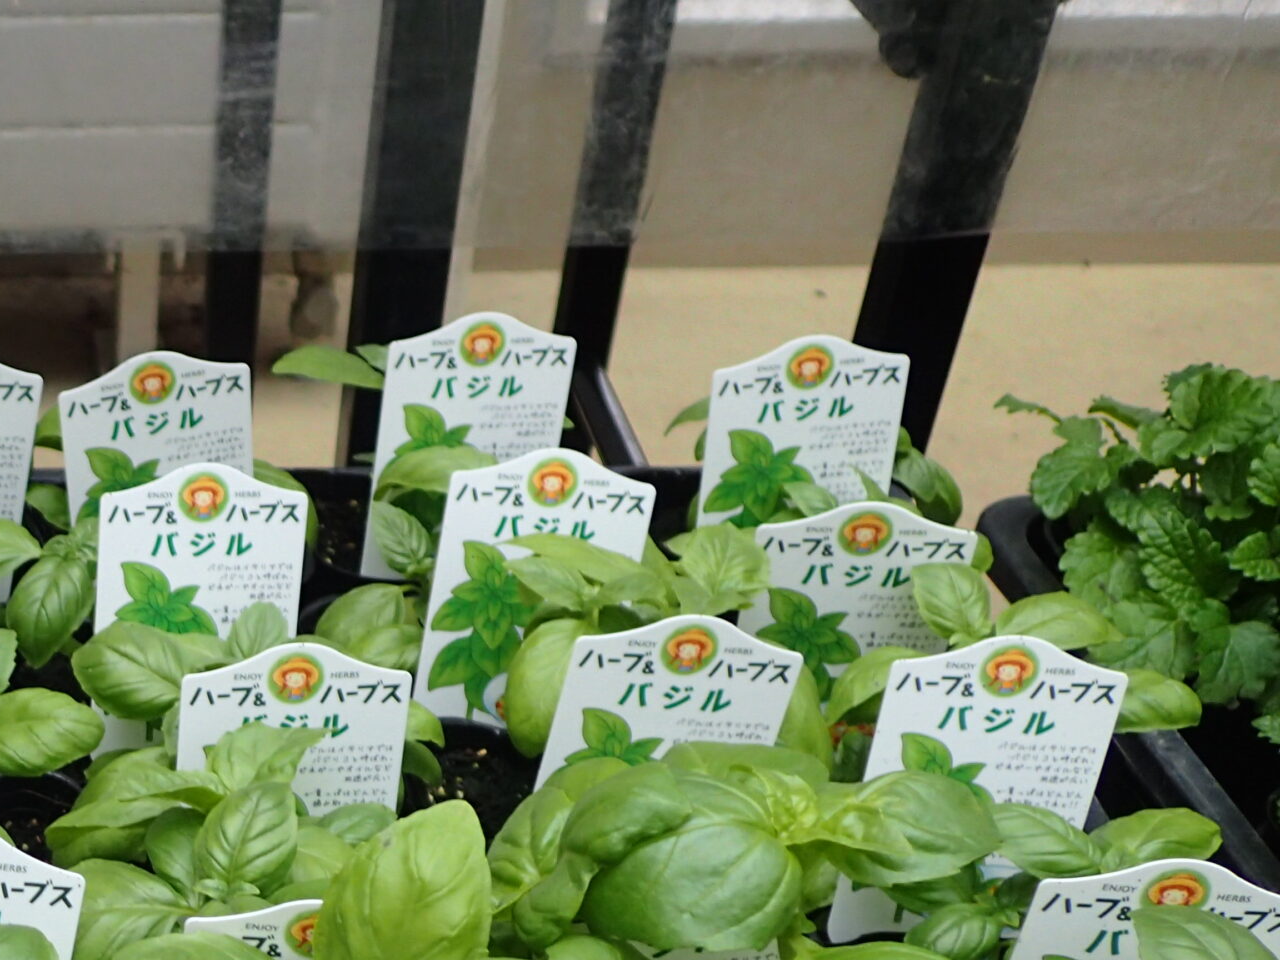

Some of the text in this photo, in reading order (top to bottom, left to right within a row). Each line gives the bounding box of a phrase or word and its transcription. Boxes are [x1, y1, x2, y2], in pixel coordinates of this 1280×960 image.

[501, 345, 568, 367] ハーブス
[176, 373, 244, 401] ハーブス
[431, 375, 523, 398] バジル
[830, 364, 900, 388] ハーブス
[757, 396, 854, 423] バジル
[111, 408, 203, 440] バジル
[226, 500, 300, 523] ハーブス
[572, 490, 645, 515] ハーブス
[494, 515, 595, 540] バジル
[151, 532, 253, 557] バジル
[885, 538, 966, 560] ハーブス
[801, 563, 911, 588] バジル
[234, 673, 263, 681] ENJOY
[708, 659, 792, 684] ハーブス
[946, 662, 1076, 676] ENJOY HERBS
[320, 680, 402, 704] ハーブス
[618, 682, 731, 712] バジル
[1030, 679, 1117, 705] ハーブス
[938, 706, 1055, 735] バジル
[1102, 883, 1251, 903] ENJOY HERBS
[245, 923, 279, 932] ENJOY
